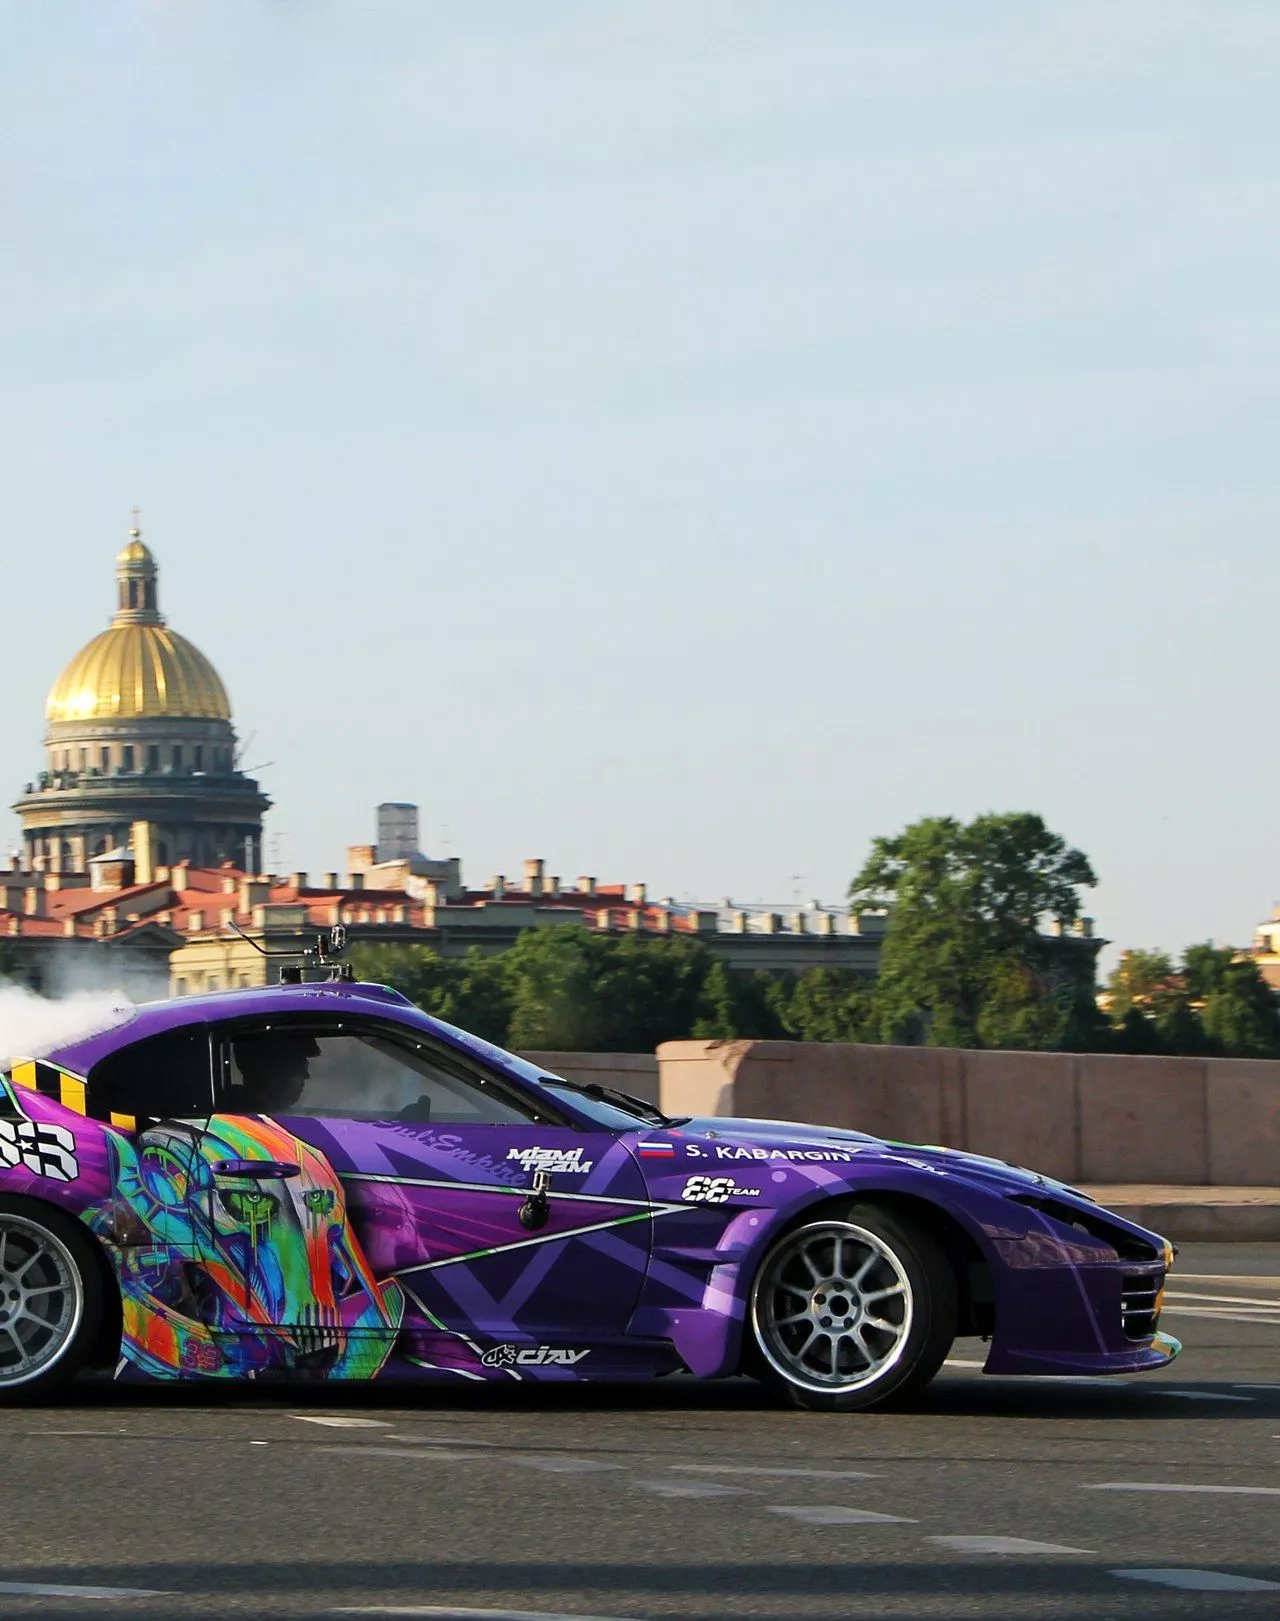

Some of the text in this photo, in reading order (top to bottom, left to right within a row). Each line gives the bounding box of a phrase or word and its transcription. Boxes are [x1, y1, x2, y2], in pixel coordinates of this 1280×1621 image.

[686, 1144, 709, 1158] S.
[715, 1146, 852, 1163] KABARGIN
[726, 1187, 761, 1197] TEAM
